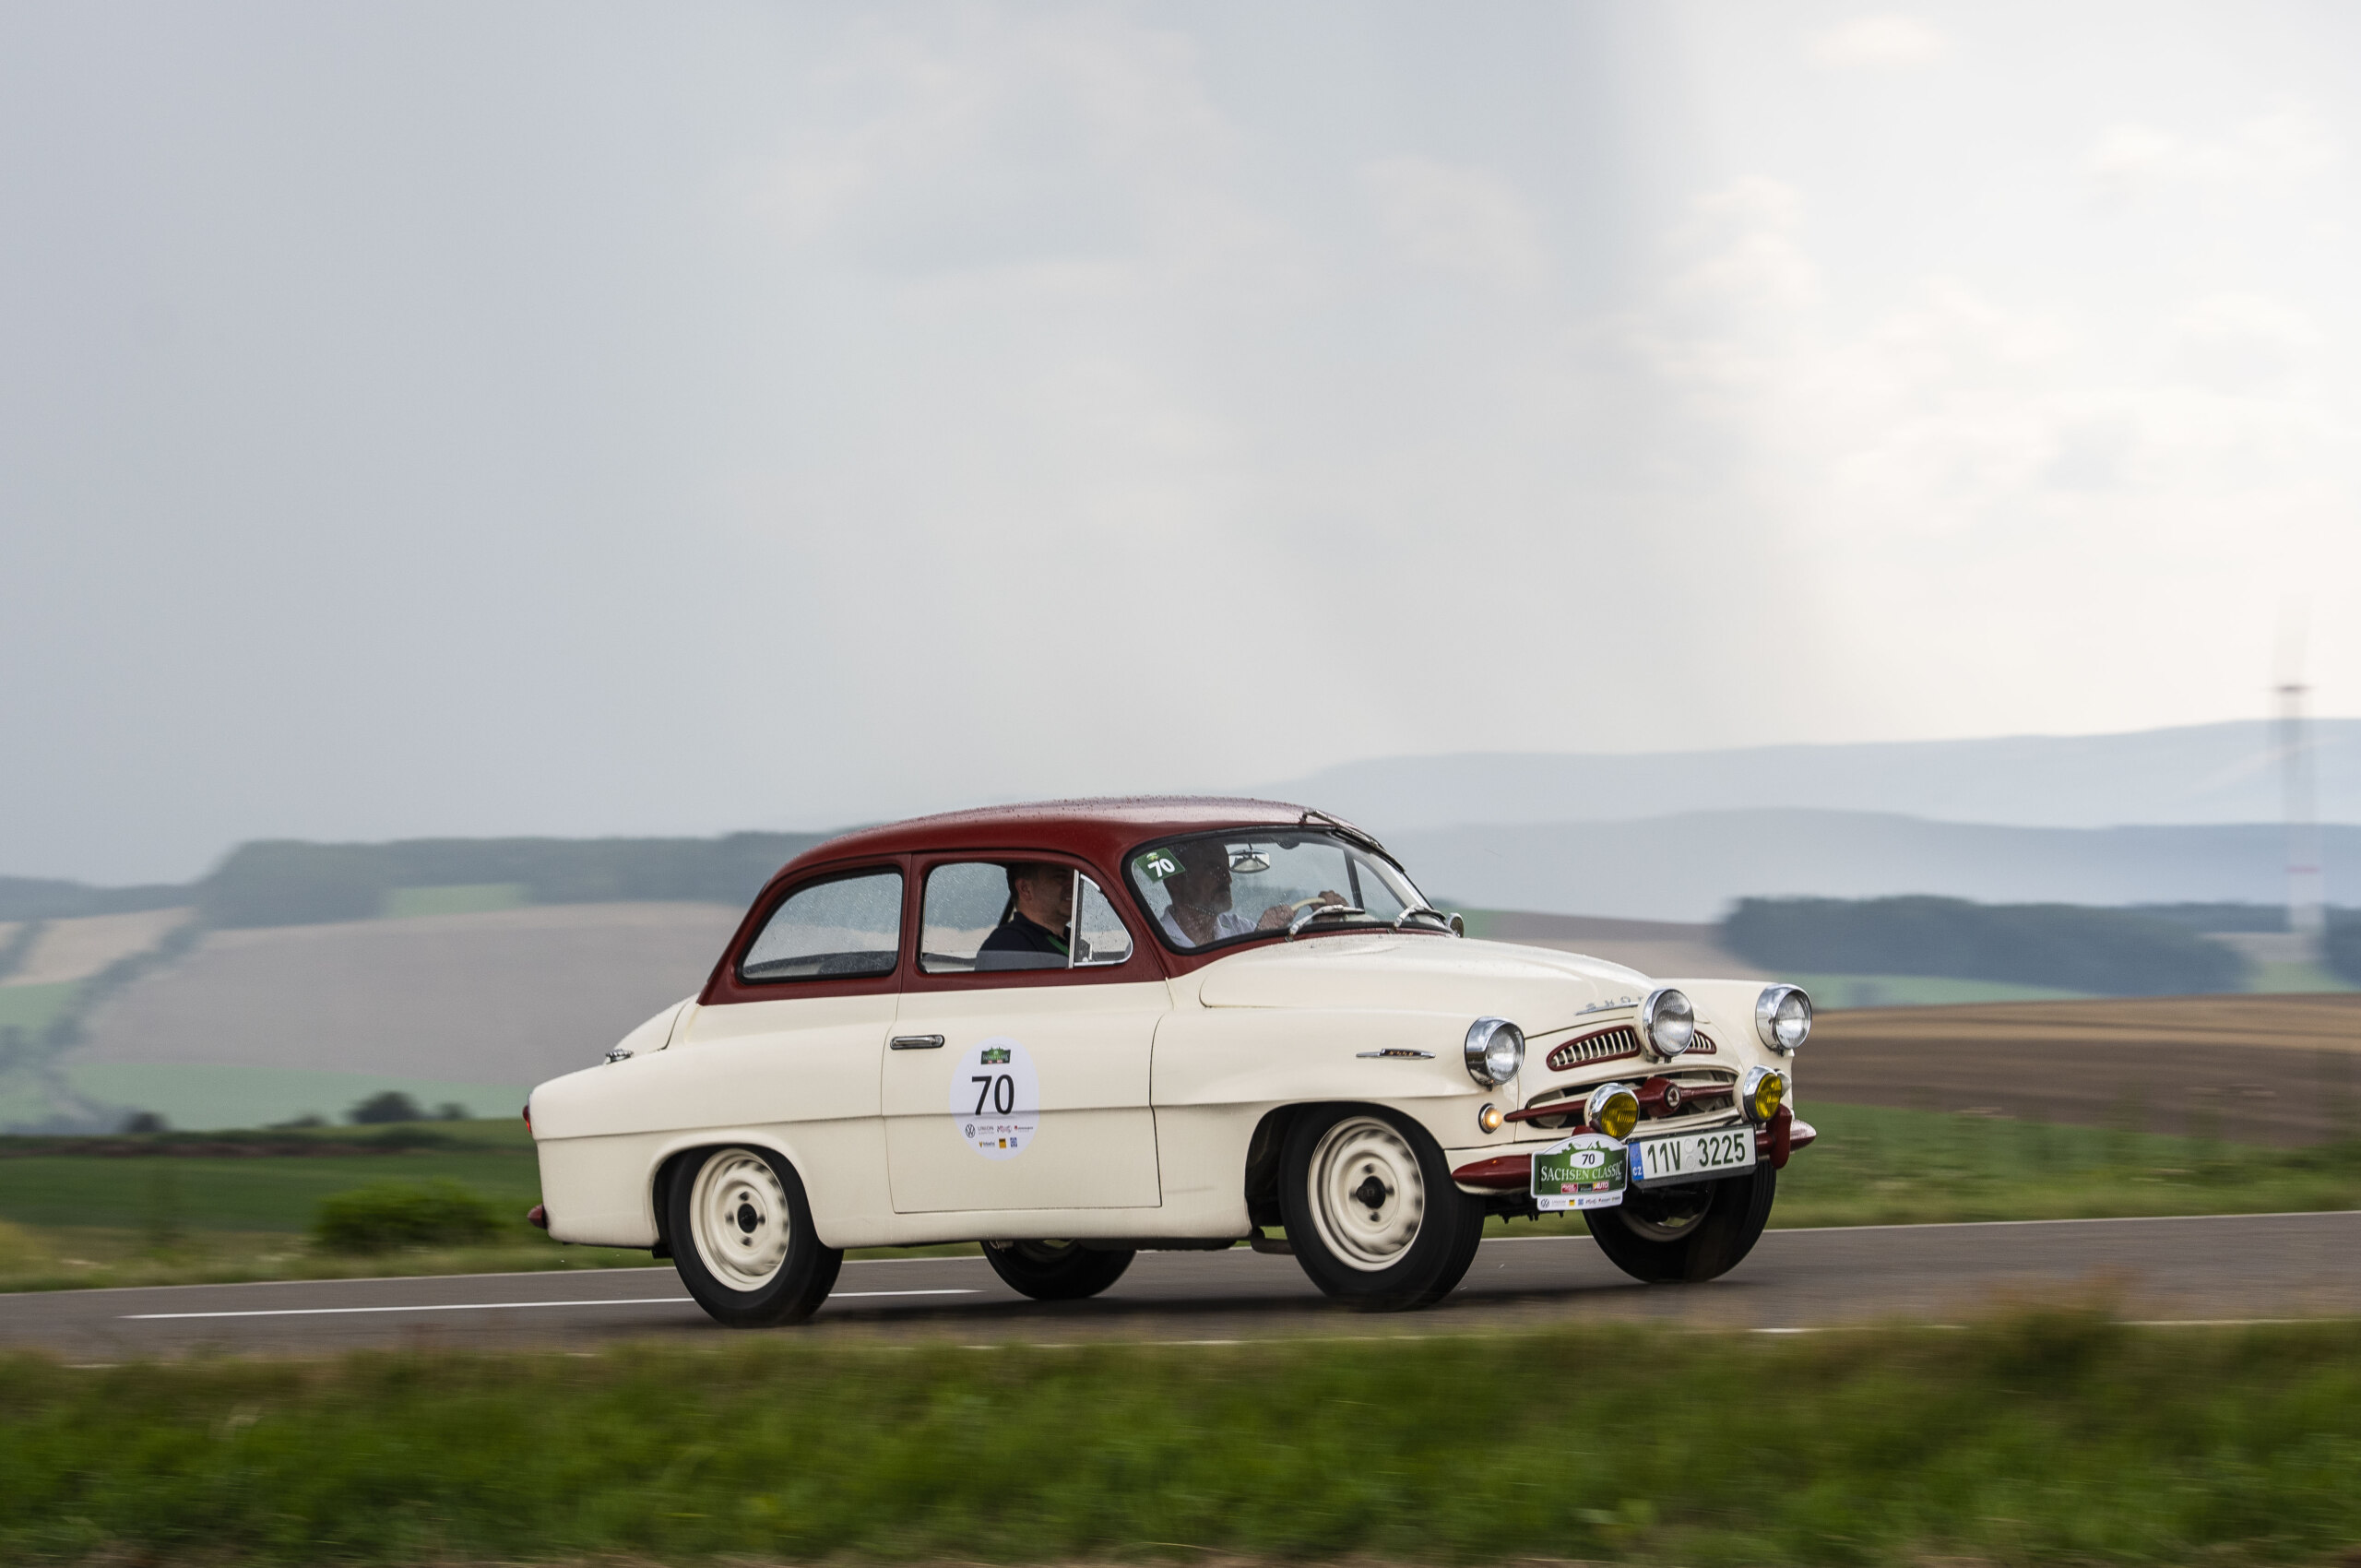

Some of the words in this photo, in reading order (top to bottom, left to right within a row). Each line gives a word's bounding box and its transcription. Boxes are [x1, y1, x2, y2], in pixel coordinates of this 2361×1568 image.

[1147, 858, 1176, 878] 70
[1585, 995, 1643, 1010] SKO
[971, 1074, 1014, 1116] 70
[1582, 1153, 1596, 1165] 70
[1647, 1141, 1680, 1174] 11V
[1697, 1133, 1746, 1167] 3225
[1541, 1165, 1589, 1182] SACHSEN
[1592, 1159, 1622, 1180] CLASSIC
[1632, 1166, 1643, 1176] CZ
